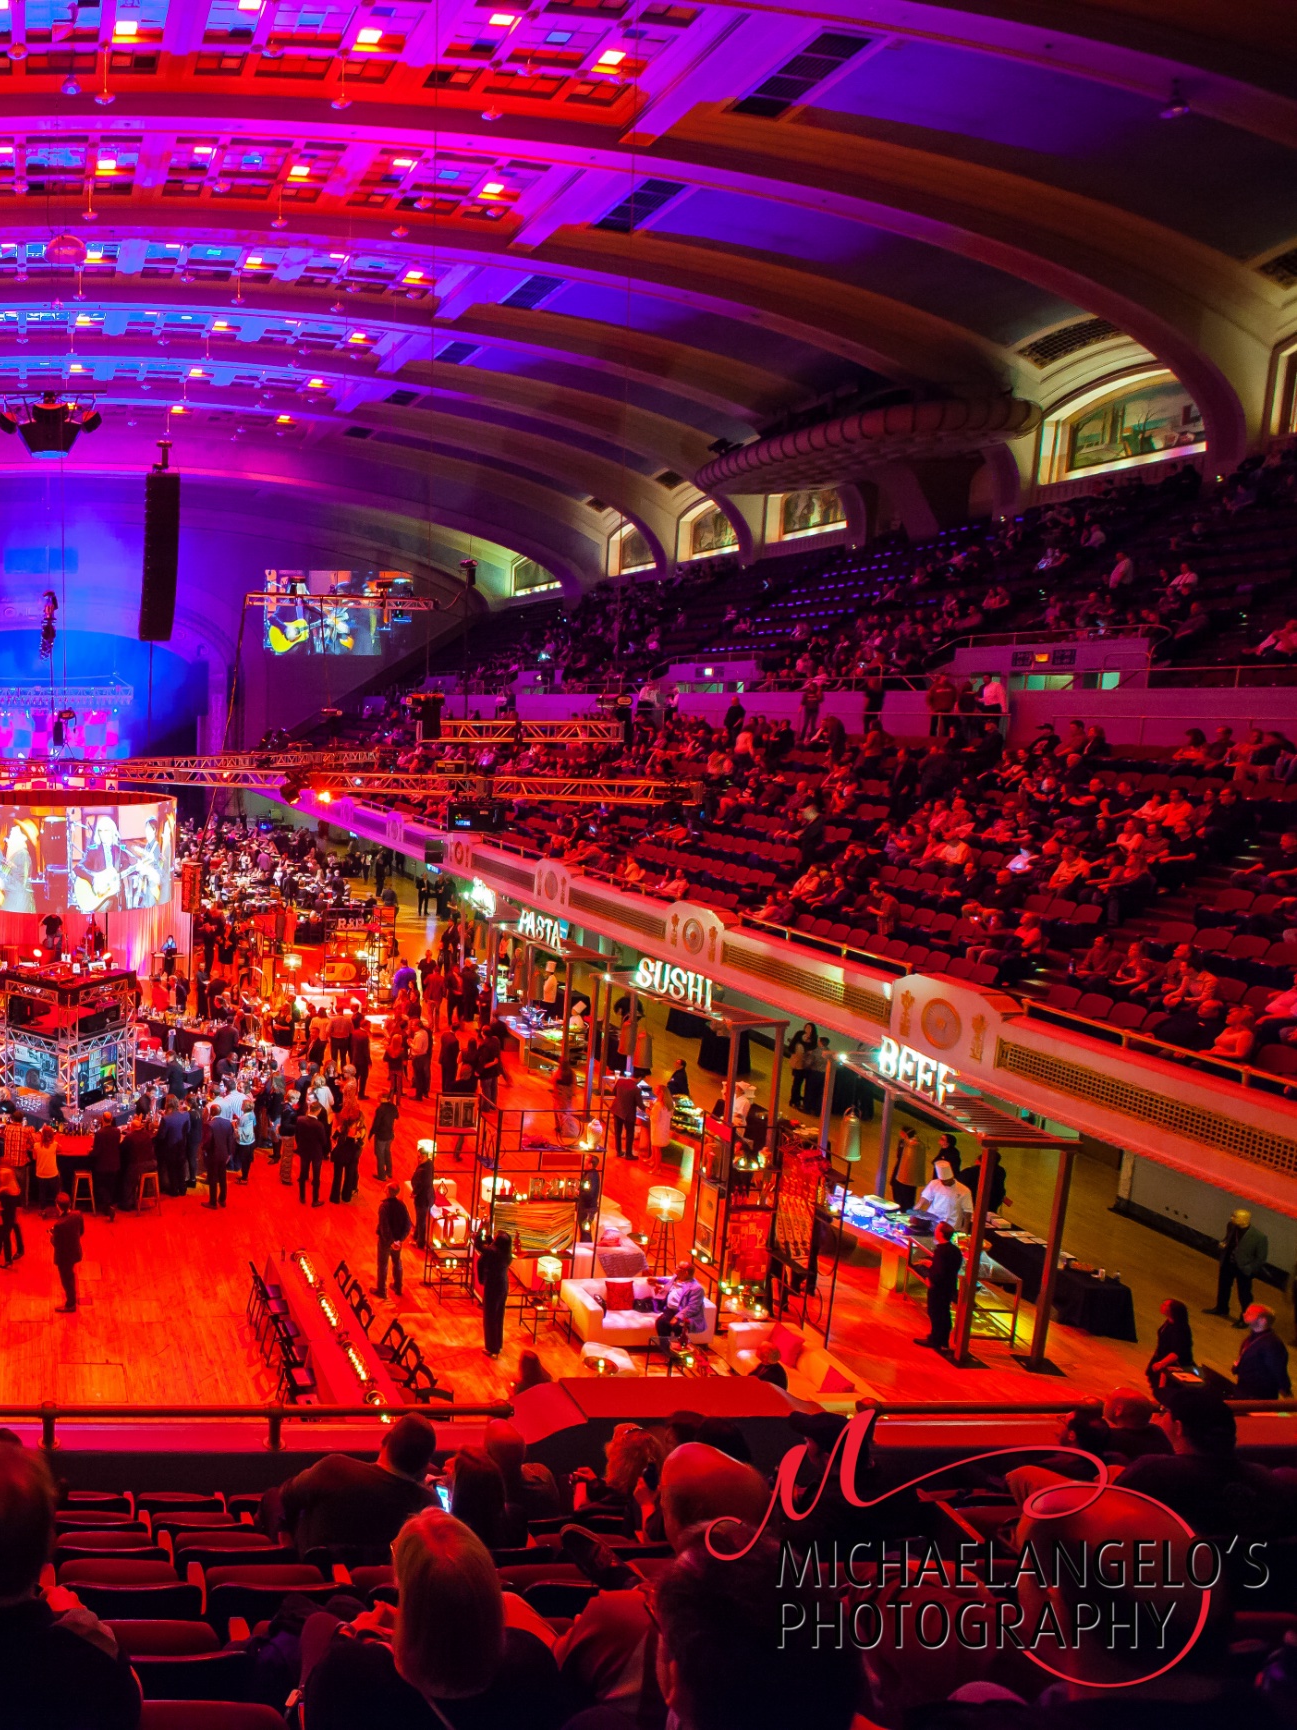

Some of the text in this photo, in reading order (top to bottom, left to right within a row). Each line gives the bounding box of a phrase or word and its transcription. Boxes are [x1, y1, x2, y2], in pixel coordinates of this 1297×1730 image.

[518, 909, 561, 949] PASTA
[635, 958, 712, 1010] SUSHI
[879, 1035, 960, 1105] BEEF
